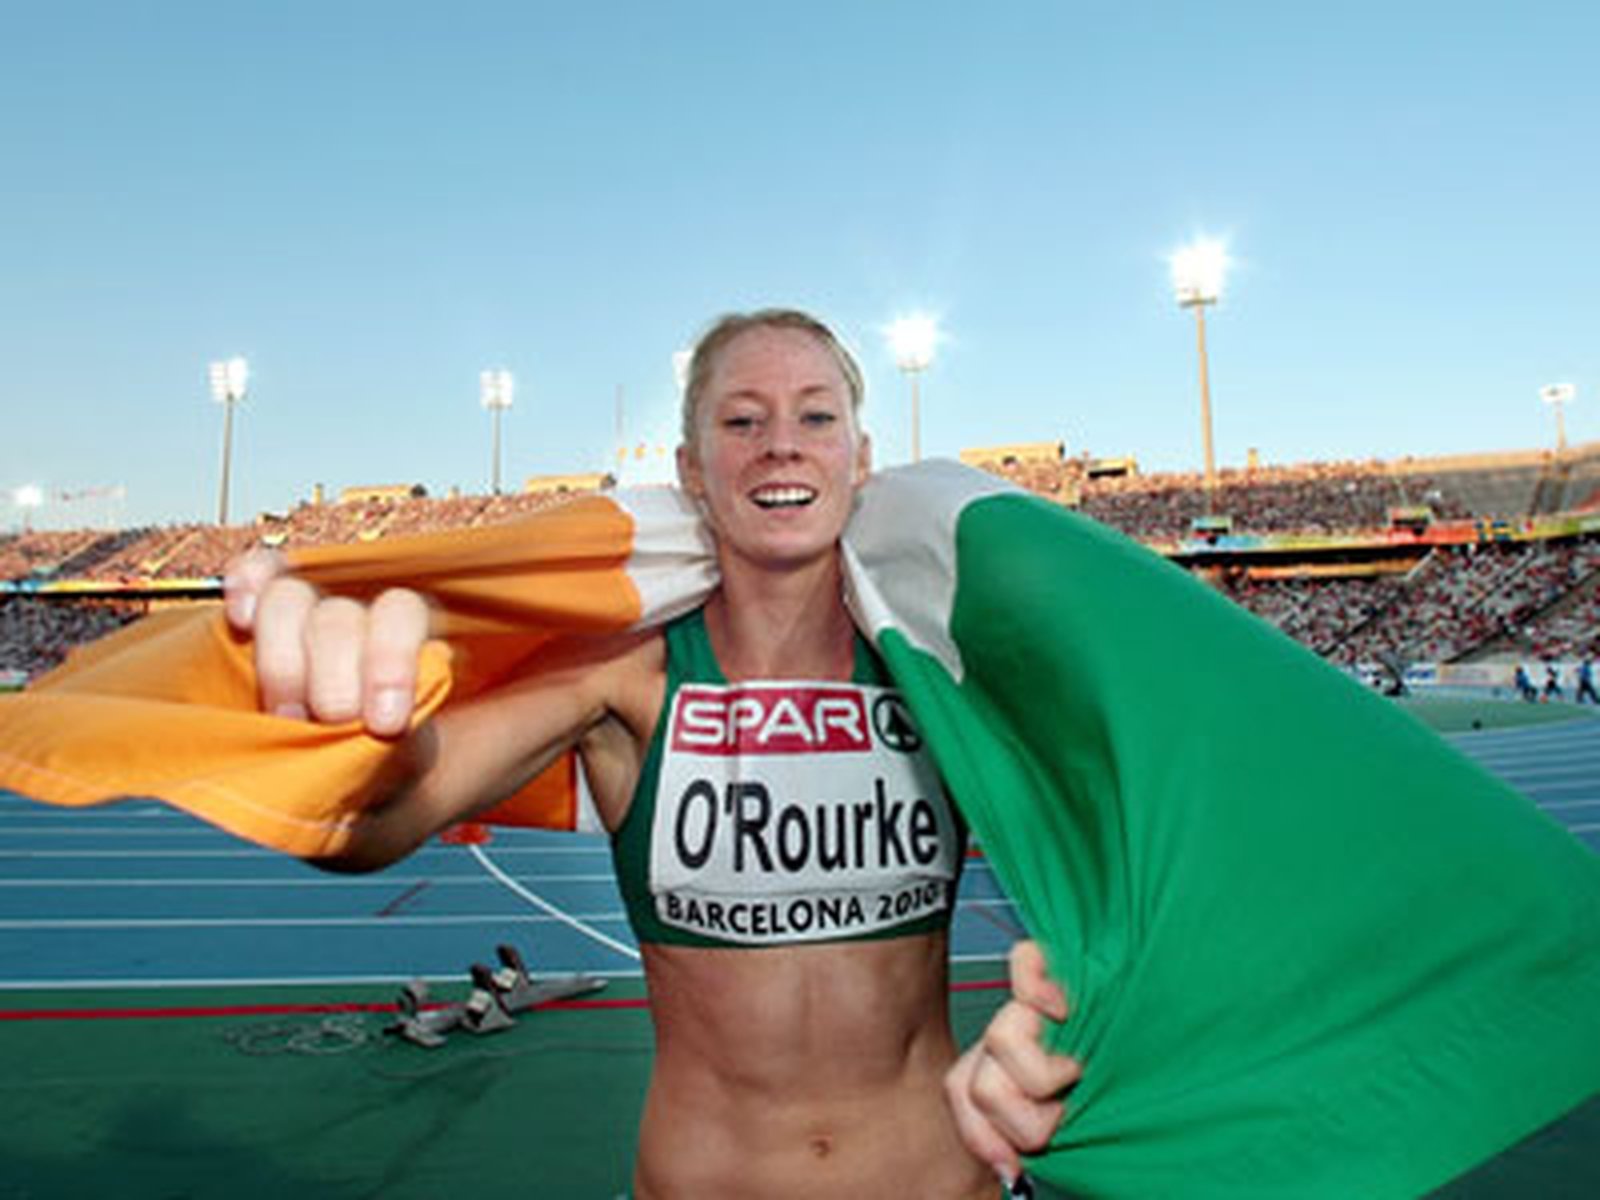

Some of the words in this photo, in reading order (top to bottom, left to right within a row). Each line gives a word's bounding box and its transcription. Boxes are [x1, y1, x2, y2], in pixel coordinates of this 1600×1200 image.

[680, 698, 864, 744] SPAR
[675, 777, 939, 872] O'Rourke
[666, 894, 866, 935] BARCELONA
[876, 882, 941, 921] 2010
